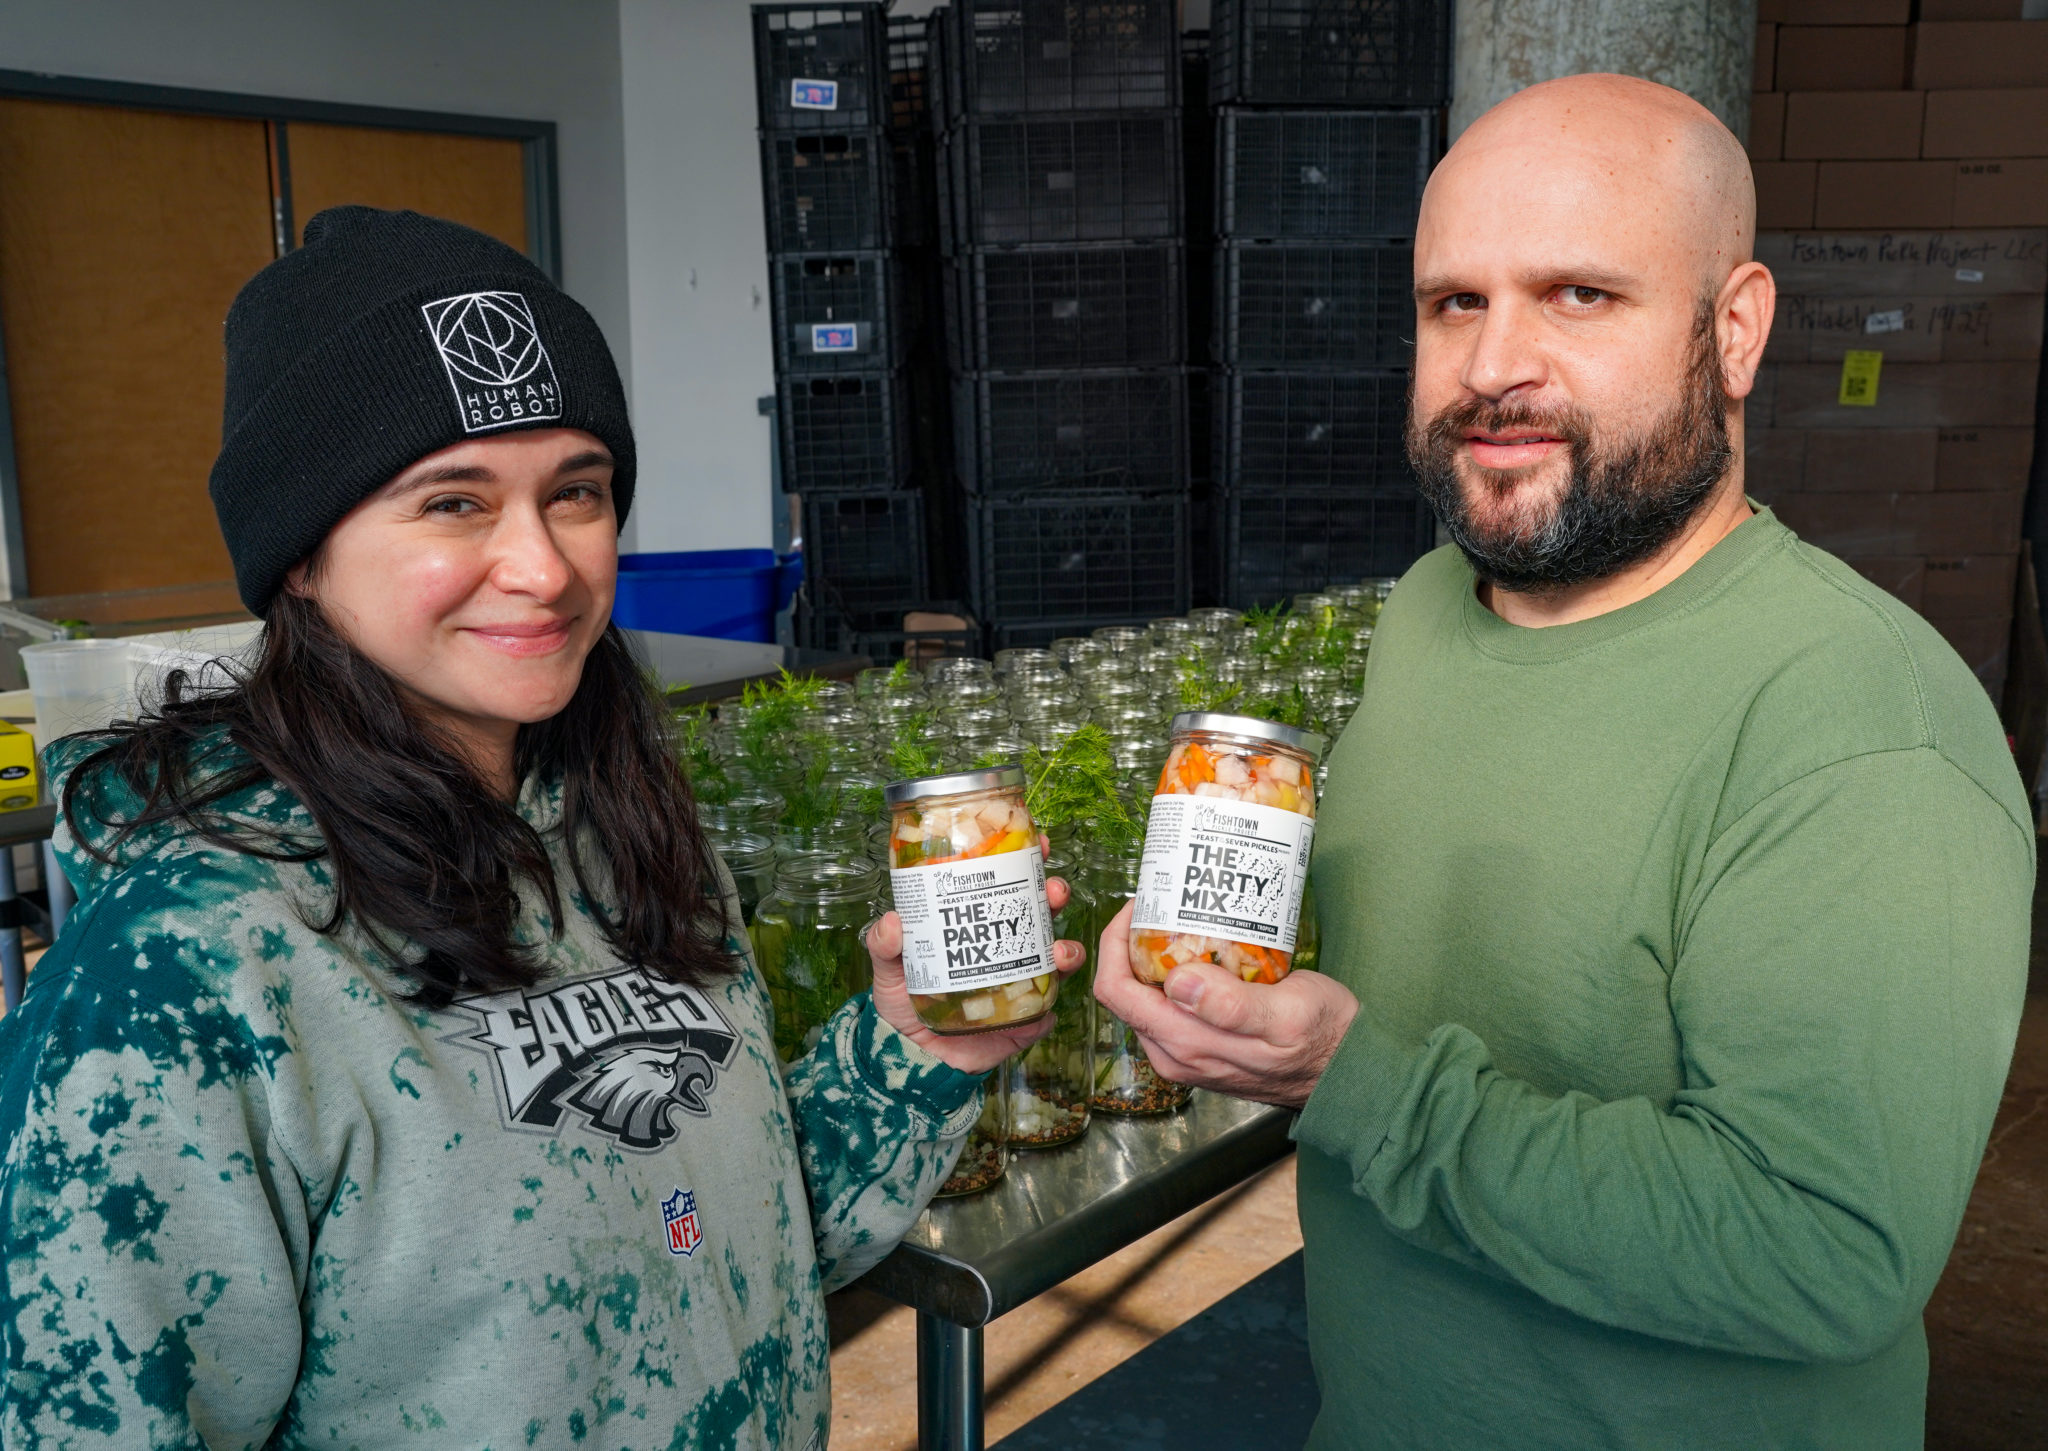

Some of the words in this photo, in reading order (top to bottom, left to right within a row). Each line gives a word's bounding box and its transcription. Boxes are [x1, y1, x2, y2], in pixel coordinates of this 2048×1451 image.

[1926, 232, 1998, 268] Project
[467, 382, 555, 408] HUMAN
[471, 398, 556, 425] ROBOT
[1211, 824, 1232, 834] PICKLE
[1233, 827, 1258, 837] PROJECT
[1213, 813, 1259, 830] FISHTOWN
[1196, 833, 1219, 843] FEAST
[1225, 837, 1250, 848] SEVEN
[1251, 842, 1279, 854] PICKLES
[1189, 843, 1239, 870] THE
[953, 870, 996, 887] FISHTOWN
[954, 883, 973, 892] PICKLE
[974, 880, 996, 889] PROJECT
[1184, 865, 1270, 897] PARTY
[943, 896, 964, 905] FEAST
[970, 892, 993, 901] SEVEN
[993, 887, 1019, 897] PICKLES
[1180, 887, 1230, 914] MIX
[939, 902, 987, 927] THE
[1180, 911, 1197, 920] KAFFIR
[1197, 914, 1210, 922] LIME
[1217, 917, 1235, 926] MILDLY
[1236, 919, 1252, 929] SWEET
[1256, 923, 1276, 934] TROPICAL
[943, 917, 1020, 948] PARTY
[946, 943, 991, 968] MIX
[967, 968, 979, 976] LIME
[984, 965, 1001, 973] MILDLY
[1001, 962, 1017, 971] SWEET
[1021, 957, 1039, 967] TROPICAL
[452, 967, 738, 1121] EAGLES
[669, 1215, 701, 1249] NFL
